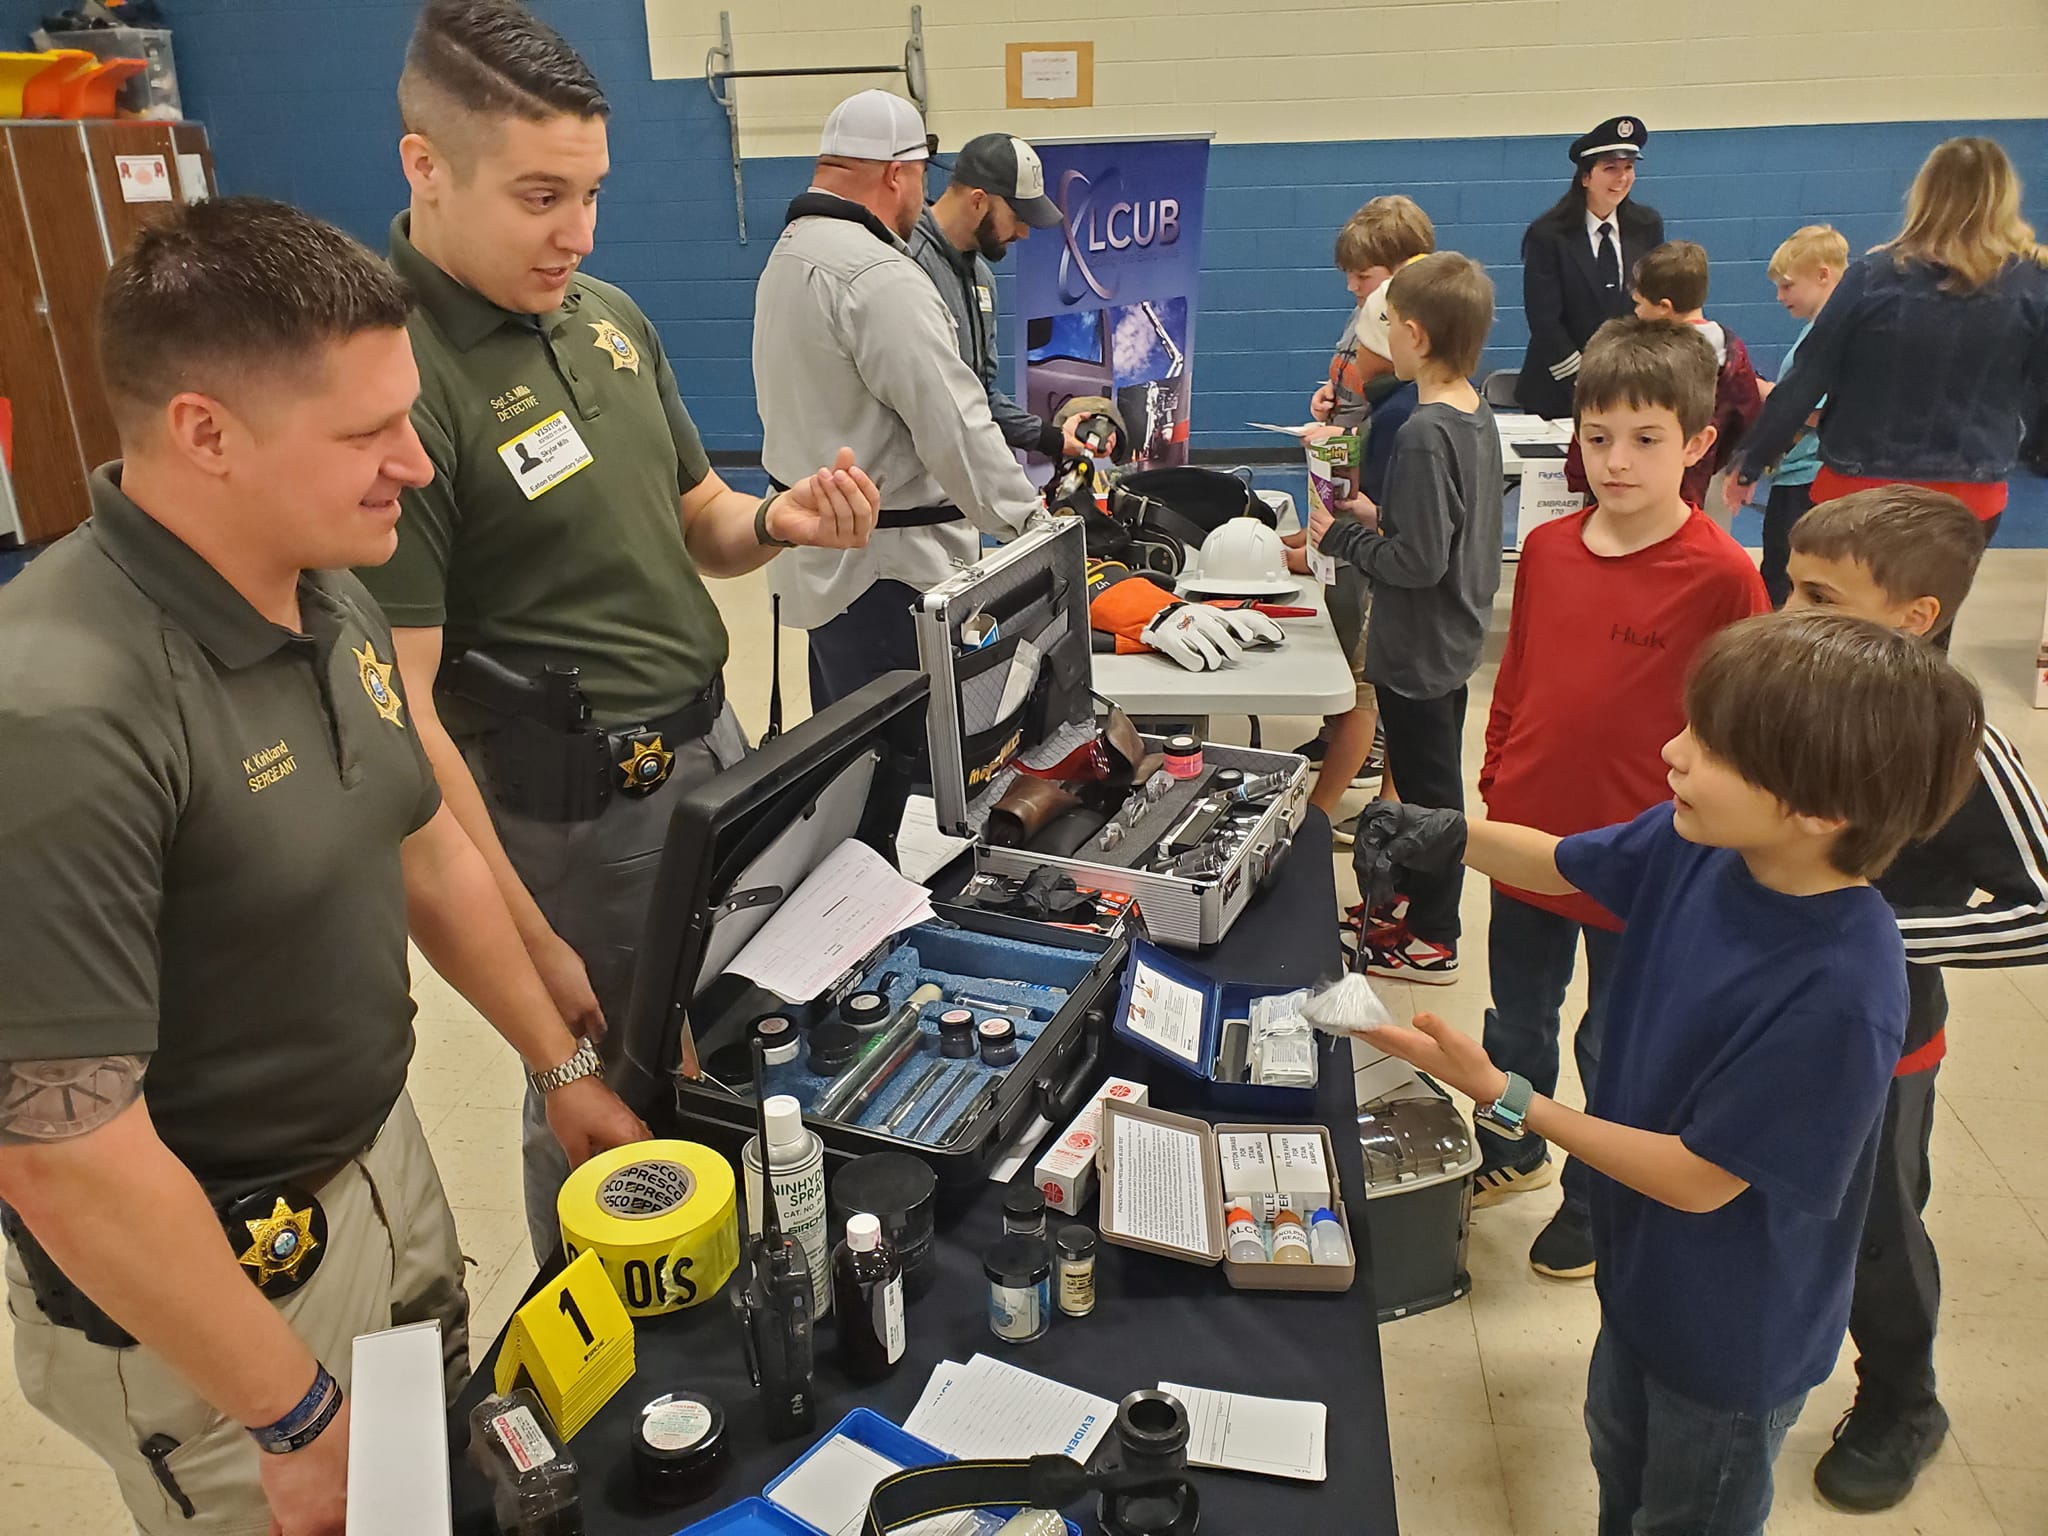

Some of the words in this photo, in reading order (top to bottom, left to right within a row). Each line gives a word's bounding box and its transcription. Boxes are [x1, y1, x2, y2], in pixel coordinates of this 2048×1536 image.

[1089, 199, 1180, 252] LCUB
[496, 395, 540, 422] DETECTIVE
[534, 418, 562, 438] VISITOR
[529, 479, 548, 492] Eaton
[547, 460, 577, 482] Elementary
[1537, 500, 1579, 508] EMBRAER
[252, 739, 289, 769] Kirkland
[248, 755, 298, 793] SERGEANT
[1231, 1151, 1241, 1170] COTTON
[1284, 1152, 1293, 1168] FILTER
[1292, 1147, 1300, 1157] FOR
[627, 1167, 683, 1201] PRESCO
[634, 1183, 674, 1207] PRES
[773, 1167, 823, 1196] NINHYD
[783, 1209, 802, 1219] CAT.
[803, 1203, 816, 1213] NO.
[788, 1208, 825, 1234] SIRCH
[559, 1288, 594, 1347] 1
[1063, 1415, 1096, 1457] EVIDEN
